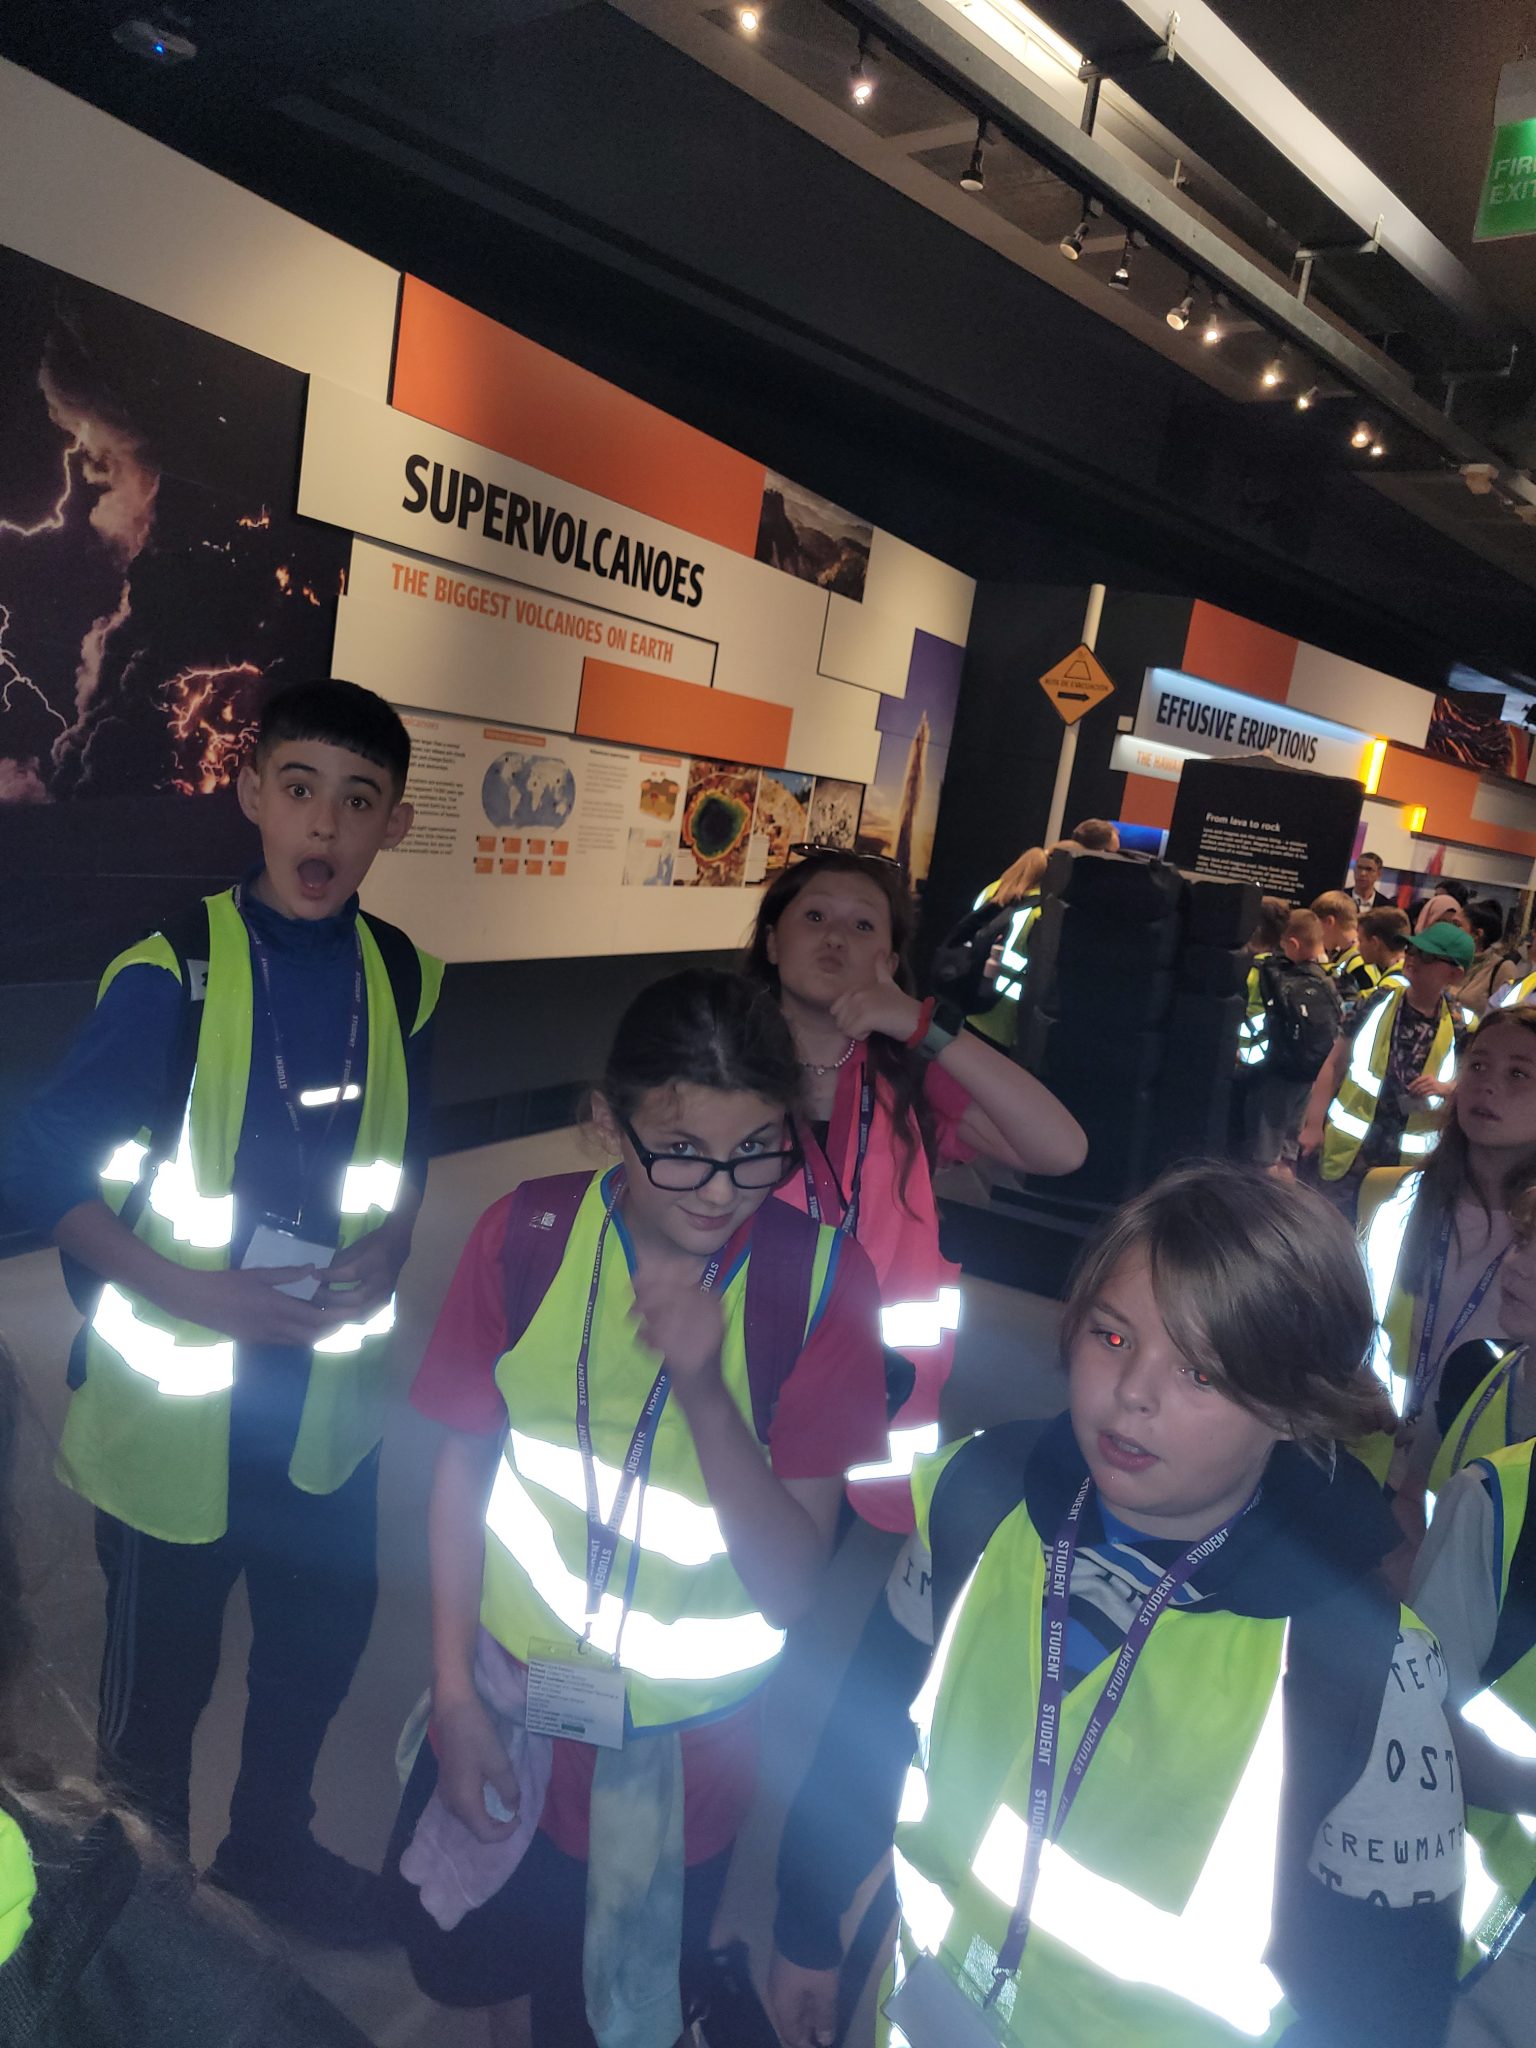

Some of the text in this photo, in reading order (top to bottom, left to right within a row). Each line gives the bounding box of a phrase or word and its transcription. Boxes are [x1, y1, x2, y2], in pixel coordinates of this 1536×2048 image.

[1494, 156, 1536, 180] FIR
[402, 454, 705, 607] SUPERVOLCANOES
[392, 563, 674, 664] THE BIGGEST VOLCANOES ON EARTH
[1156, 692, 1318, 763] EFFUSIVE ERUPTIONS
[1206, 812, 1281, 832] From lava to rock
[276, 1056, 288, 1089] STUDENT
[809, 1196, 820, 1219] STUDE
[701, 1261, 720, 1293] STUDE
[626, 1431, 646, 1475] STUDENT
[1068, 1476, 1090, 1522] STUDENT
[1053, 1540, 1070, 1599] STUDENT
[1186, 1527, 1230, 1565] STUDENT
[1138, 1573, 1177, 1626] STUDENT
[1046, 1620, 1063, 1681] STUDENT
[1106, 1643, 1135, 1701] STUDENT
[1038, 1703, 1056, 1765] STUDENT
[1073, 1717, 1103, 1776] STUDENT
